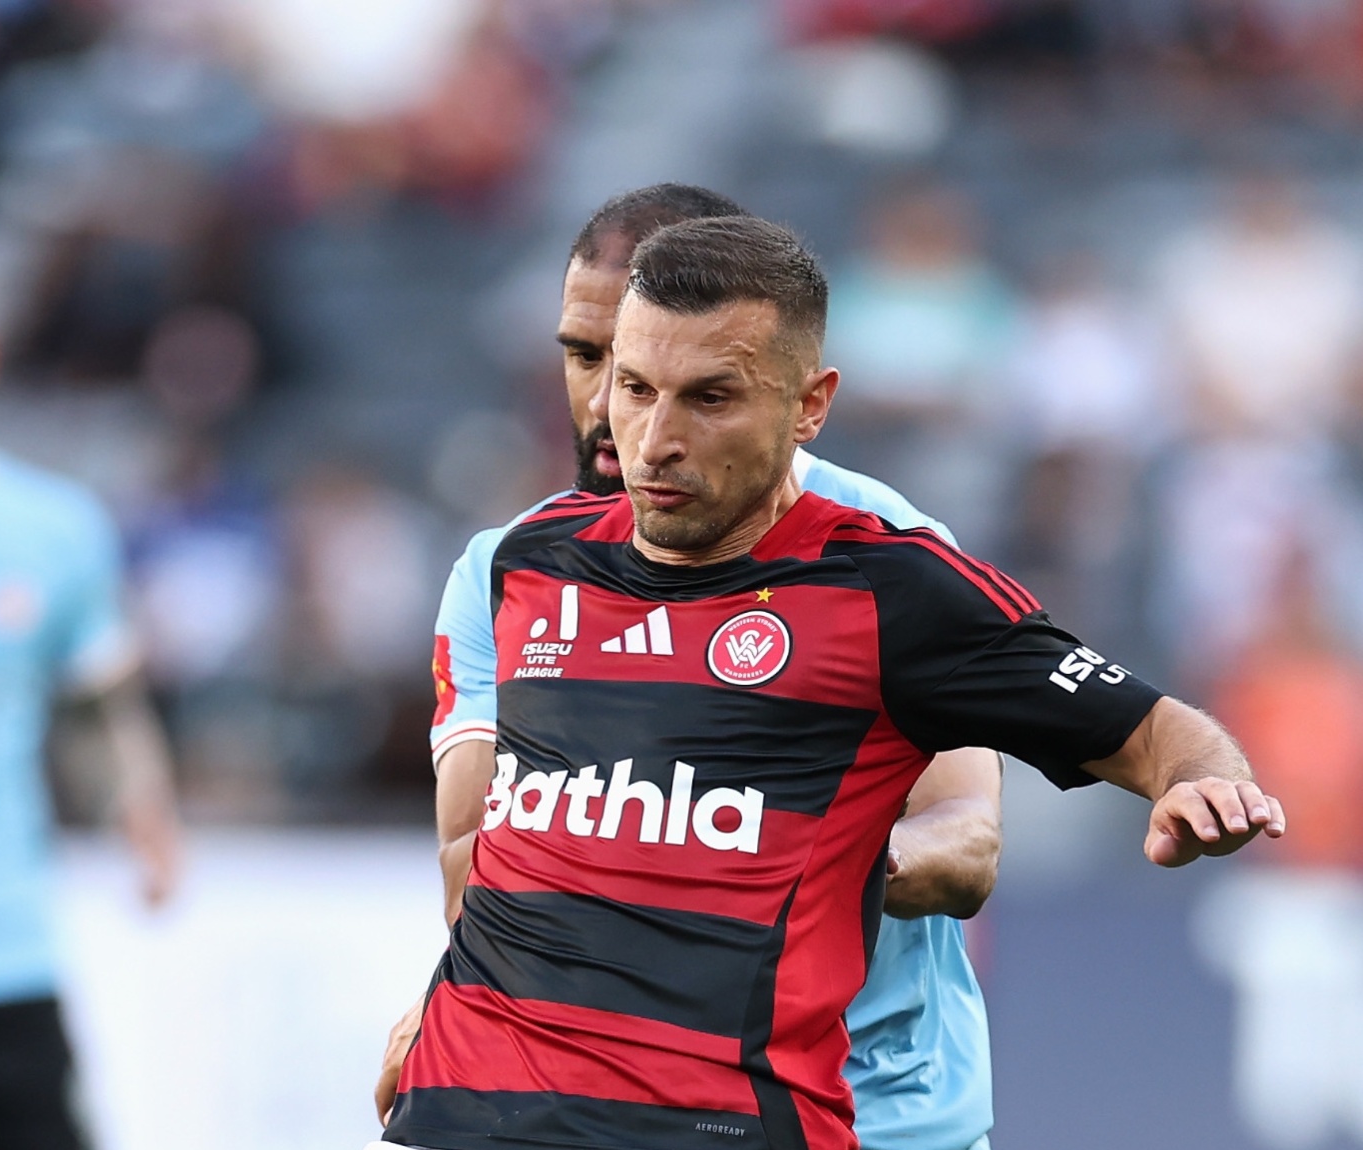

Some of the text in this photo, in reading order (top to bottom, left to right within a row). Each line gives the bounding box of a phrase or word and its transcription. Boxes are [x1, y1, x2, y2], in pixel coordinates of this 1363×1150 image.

[727, 617, 755, 632] WESTERN
[521, 642, 573, 656] ISUZU
[526, 655, 557, 665] UTE
[513, 667, 564, 678] A-LEAGUE
[724, 667, 764, 679] WANDERERS
[1048, 646, 1106, 693] ISU
[481, 753, 765, 854] Bathla
[695, 1122, 746, 1137] AEROREADY
